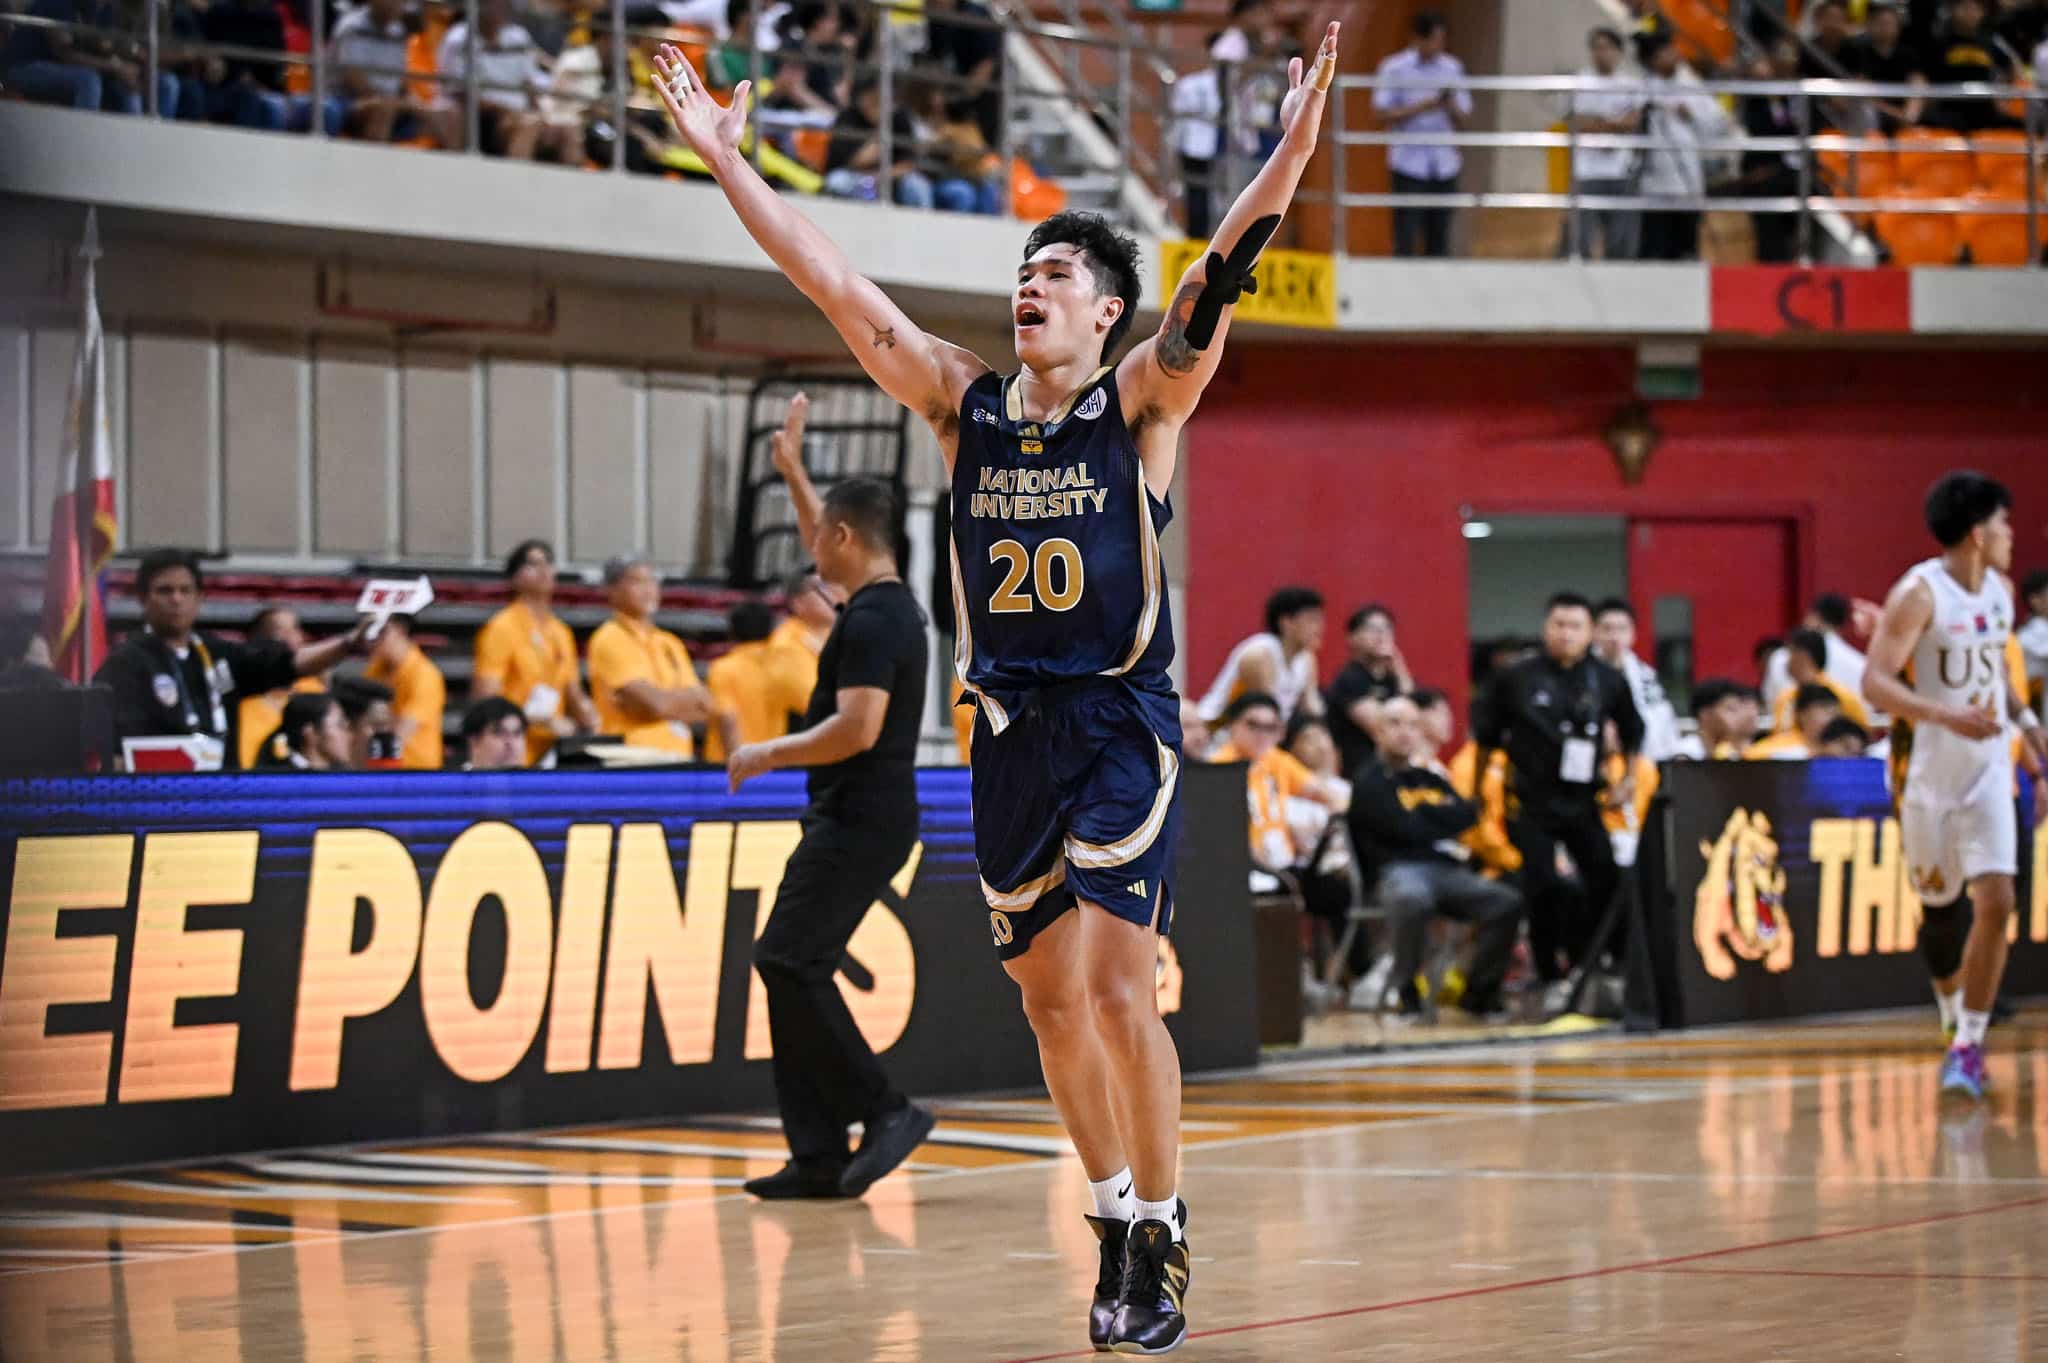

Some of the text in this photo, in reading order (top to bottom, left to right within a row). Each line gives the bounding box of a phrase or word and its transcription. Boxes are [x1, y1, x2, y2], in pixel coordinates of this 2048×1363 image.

[1778, 273, 1844, 331] C1
[978, 462, 1094, 494] NATIONAL
[971, 487, 1108, 520] UNVERSITY
[989, 537, 1084, 613] 20
[990, 910, 1014, 946] 0
[288, 820, 924, 1091] POINTS
